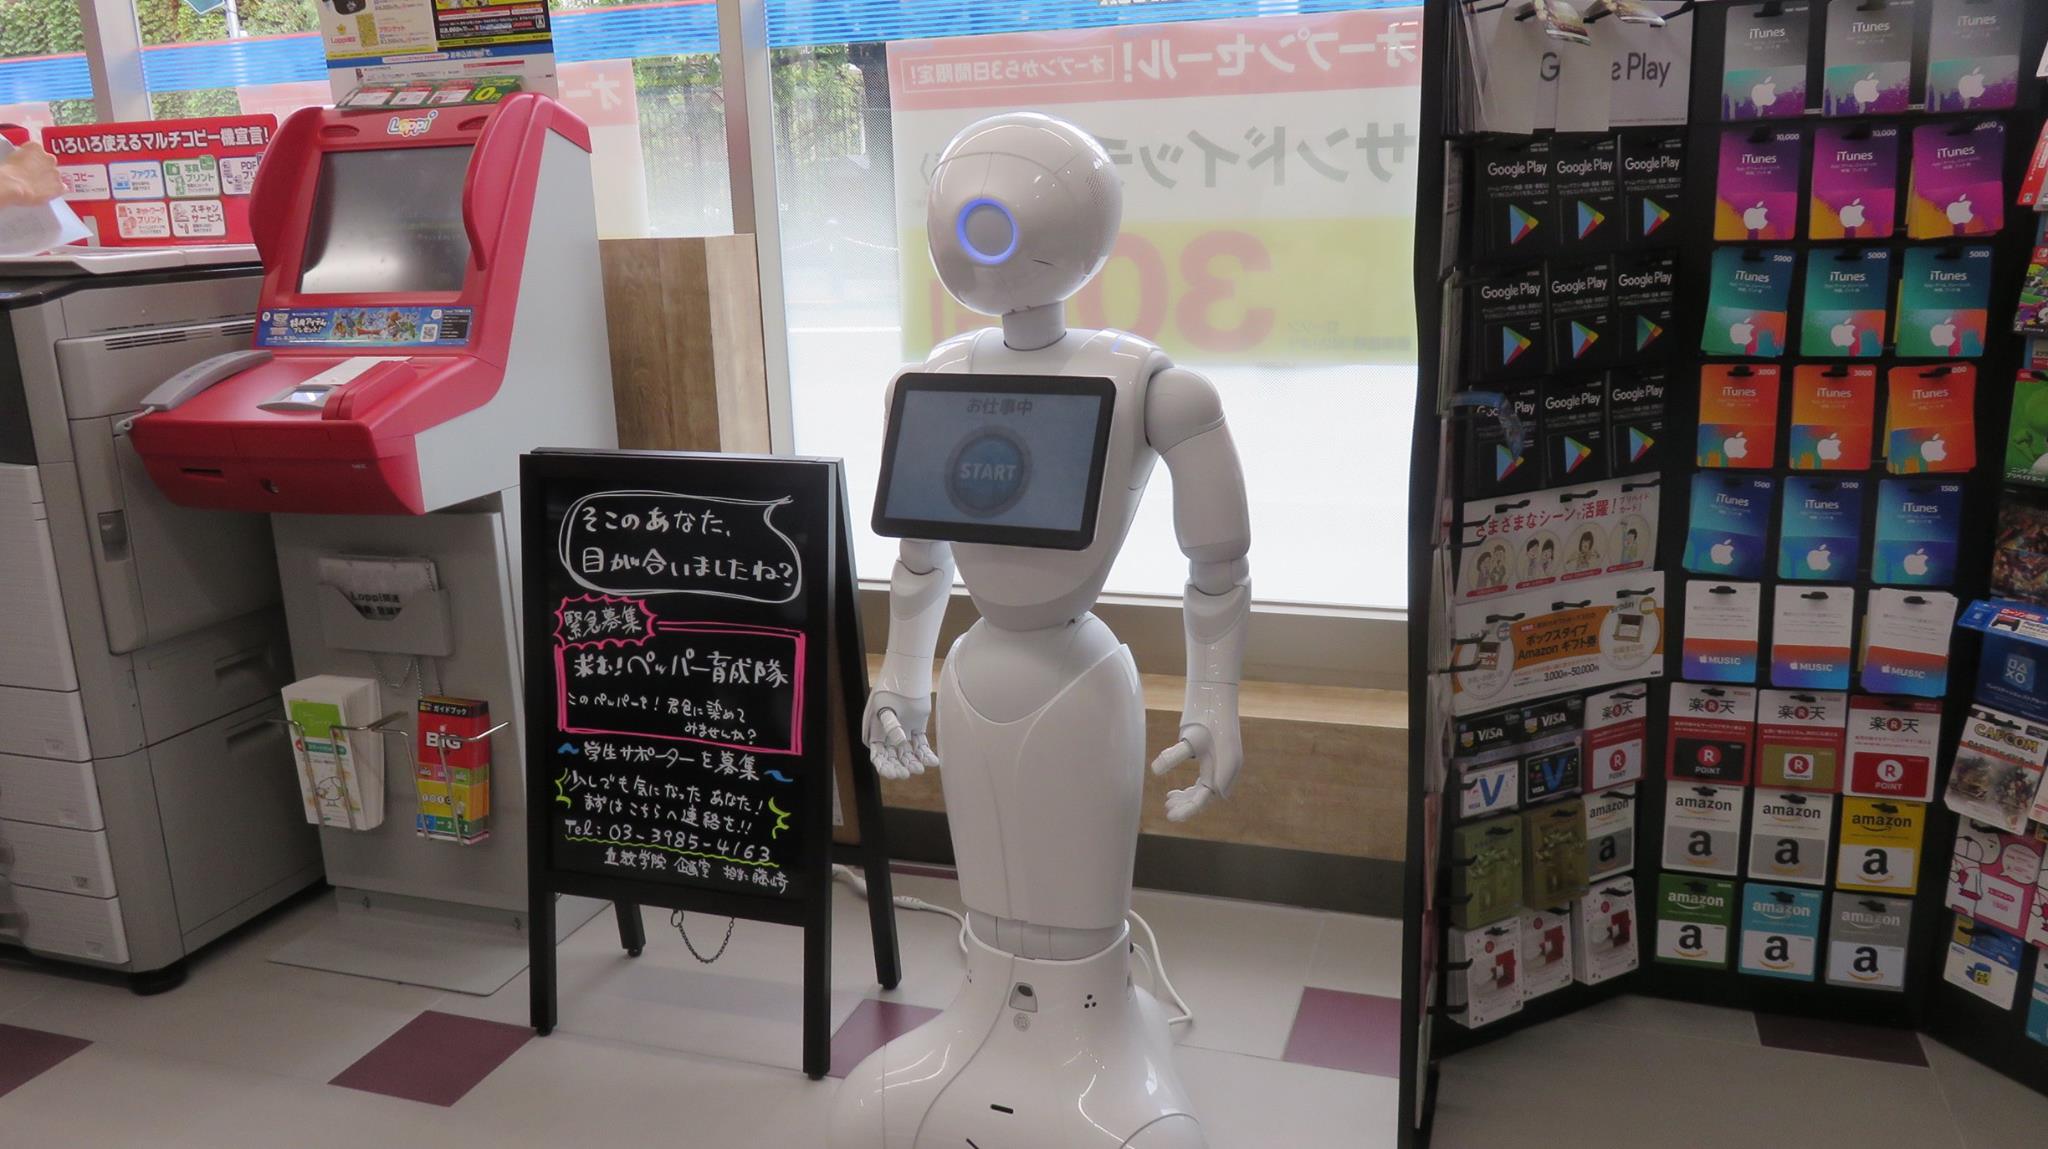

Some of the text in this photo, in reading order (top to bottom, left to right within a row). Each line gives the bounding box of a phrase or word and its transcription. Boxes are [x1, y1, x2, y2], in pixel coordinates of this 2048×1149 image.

[1852, 21, 1890, 33] iTunes
[1957, 14, 1997, 27] iTunes
[1750, 27, 1785, 39] iTunes
[1626, 52, 1671, 88] Play
[388, 112, 432, 136] Loppi
[52, 127, 270, 154] いろいろ使えるマルチコピー機宣言!
[1741, 153, 1777, 164] iTunes
[1836, 151, 1873, 162] iTunes
[1936, 146, 1975, 159] iTunes
[1487, 159, 1547, 178] Google Play
[1556, 157, 1613, 176] Google Play
[1625, 154, 1680, 173] Google Play
[1618, 271, 1673, 288] Google Play
[1735, 271, 1770, 283] iTunes
[1829, 271, 1866, 282] iTunes
[1929, 271, 1967, 282] iTunes
[1481, 282, 1541, 301] Google Play
[1551, 276, 1608, 295] Google Play
[1612, 384, 1664, 401] Google Play
[1722, 386, 1756, 398] iTunes
[1816, 387, 1852, 399] iTunes
[1912, 388, 1949, 400] iTunes
[967, 398, 1033, 416] お仕事中
[1545, 393, 1600, 410] Google Play
[960, 462, 1017, 482] START
[1716, 493, 1749, 507] iTunes
[1804, 499, 1839, 510] iTunes
[1903, 502, 1938, 513] iTunes
[583, 547, 793, 587] 目が合いましたね?
[564, 606, 642, 641] 緊急募集
[1518, 643, 1559, 661] Amazon
[1709, 657, 1741, 666] MUSIC
[1800, 663, 1833, 672] MUSIC
[1891, 667, 1926, 679] MUSIC
[1541, 712, 1567, 727] VISA
[684, 722, 757, 745] みませんか?
[1477, 727, 1504, 742] VISA
[1975, 723, 2039, 753] CAPCOM
[1694, 766, 1721, 775] POINT
[1874, 781, 1902, 790] POINT
[1589, 800, 1629, 819] amazon
[1675, 795, 1732, 812] amazon
[1762, 803, 1821, 820] amazon
[1852, 813, 1912, 829] amazon
[565, 819, 770, 862] Tel: 03-3985-4163
[1688, 830, 1712, 856] a
[1775, 838, 1800, 865] a
[1862, 848, 1888, 876] a
[1668, 891, 1725, 908] amazon
[1753, 900, 1811, 918] amazon
[1841, 909, 1900, 926] amazon
[1678, 924, 1703, 950] a
[1763, 936, 1789, 962] a
[1853, 946, 1879, 973] a
